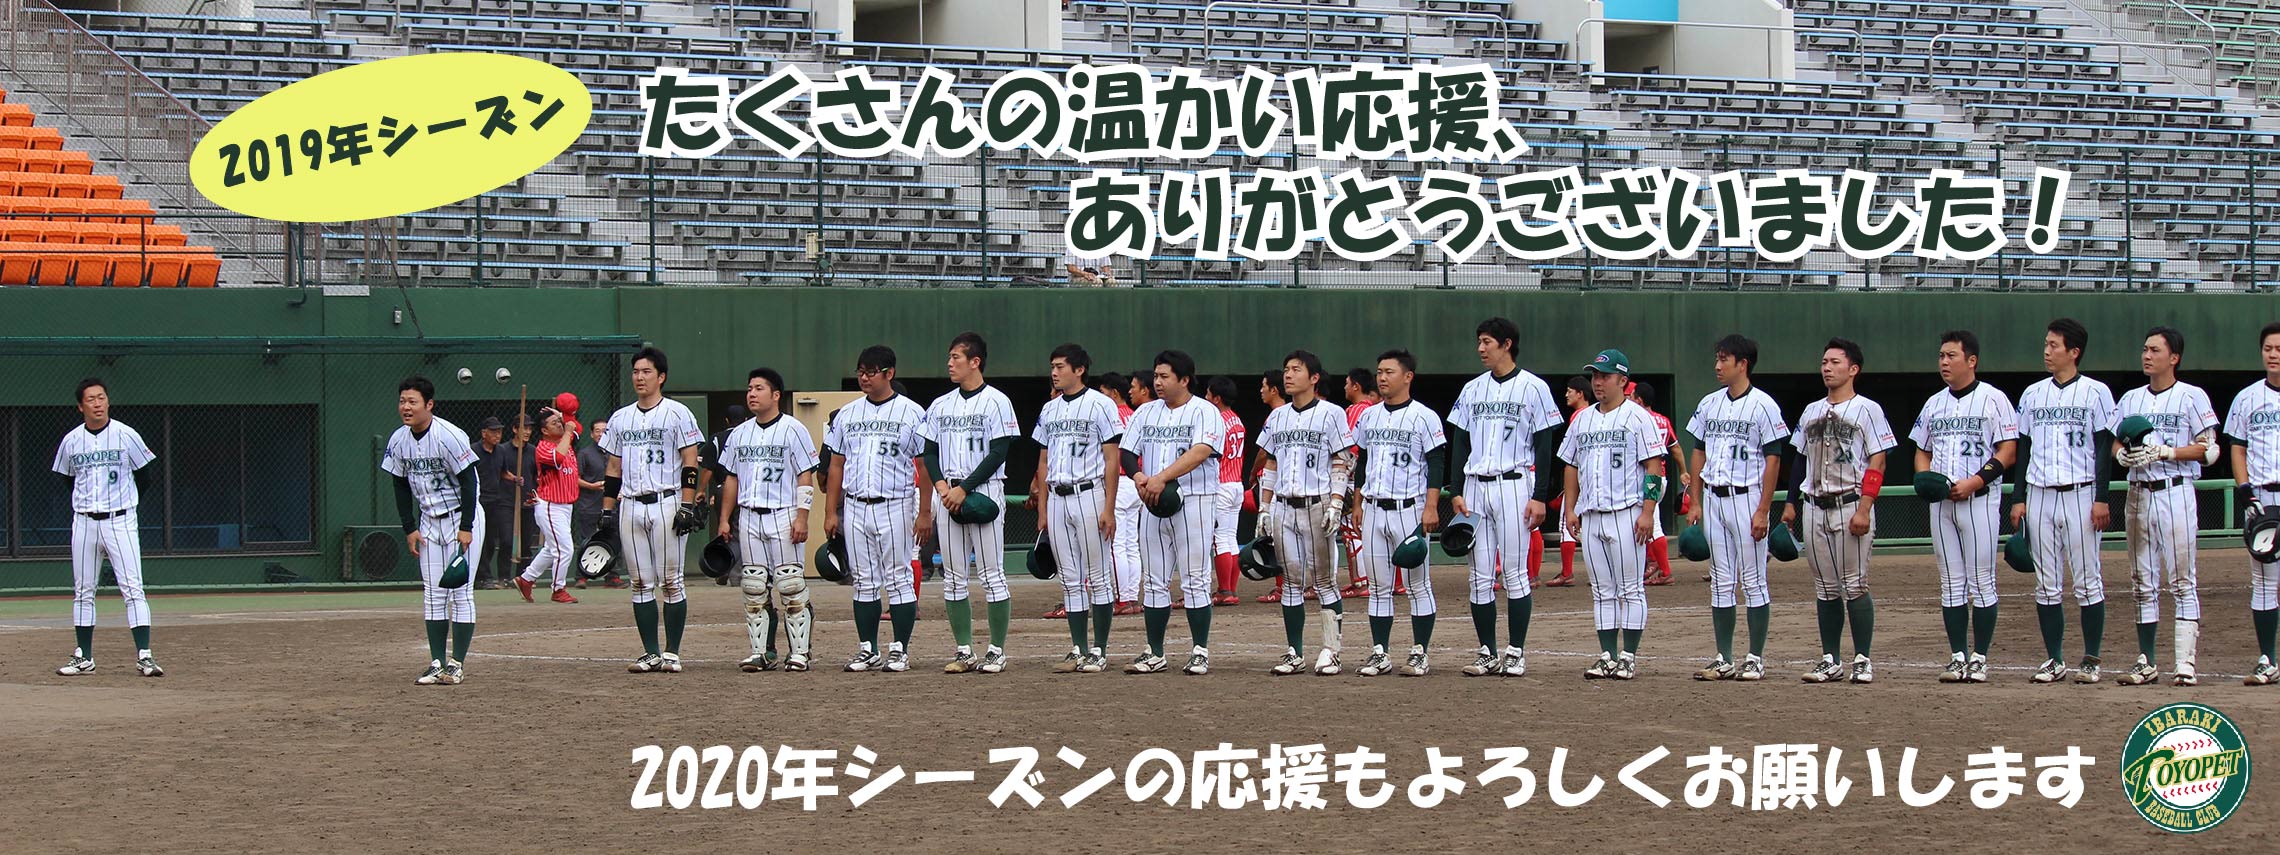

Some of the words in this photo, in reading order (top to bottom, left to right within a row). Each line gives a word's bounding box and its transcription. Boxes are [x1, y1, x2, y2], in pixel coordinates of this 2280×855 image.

[1471, 401, 1526, 418] TOYOPET
[2030, 406, 2088, 421] TOYOPET
[845, 420, 903, 433] TOYOPET
[936, 414, 988, 428] TOYOPET
[1045, 419, 1095, 433] OYOPET
[1931, 416, 1988, 431] TOYOPET
[1141, 425, 1195, 438] TOYOPET
[1272, 429, 1326, 444] TOYOPET
[1365, 428, 1417, 443] OYOPET
[1504, 425, 1515, 441] 7
[1577, 429, 1631, 445] OYOPET
[967, 437, 984, 452] 11
[1227, 432, 1245, 460] 37
[2065, 431, 2085, 448] 13
[735, 445, 789, 458] TOYOPET
[878, 441, 900, 457] 55
[1068, 442, 1089, 457] 17
[1730, 444, 1749, 461] 16
[1961, 440, 1984, 457] 25
[646, 449, 665, 464] 33
[1306, 453, 1315, 468] 8
[1390, 451, 1412, 467] 19
[1612, 453, 1623, 469] 5
[109, 470, 118, 484] 9
[562, 467, 573, 475] 90
[763, 467, 784, 483] 27
